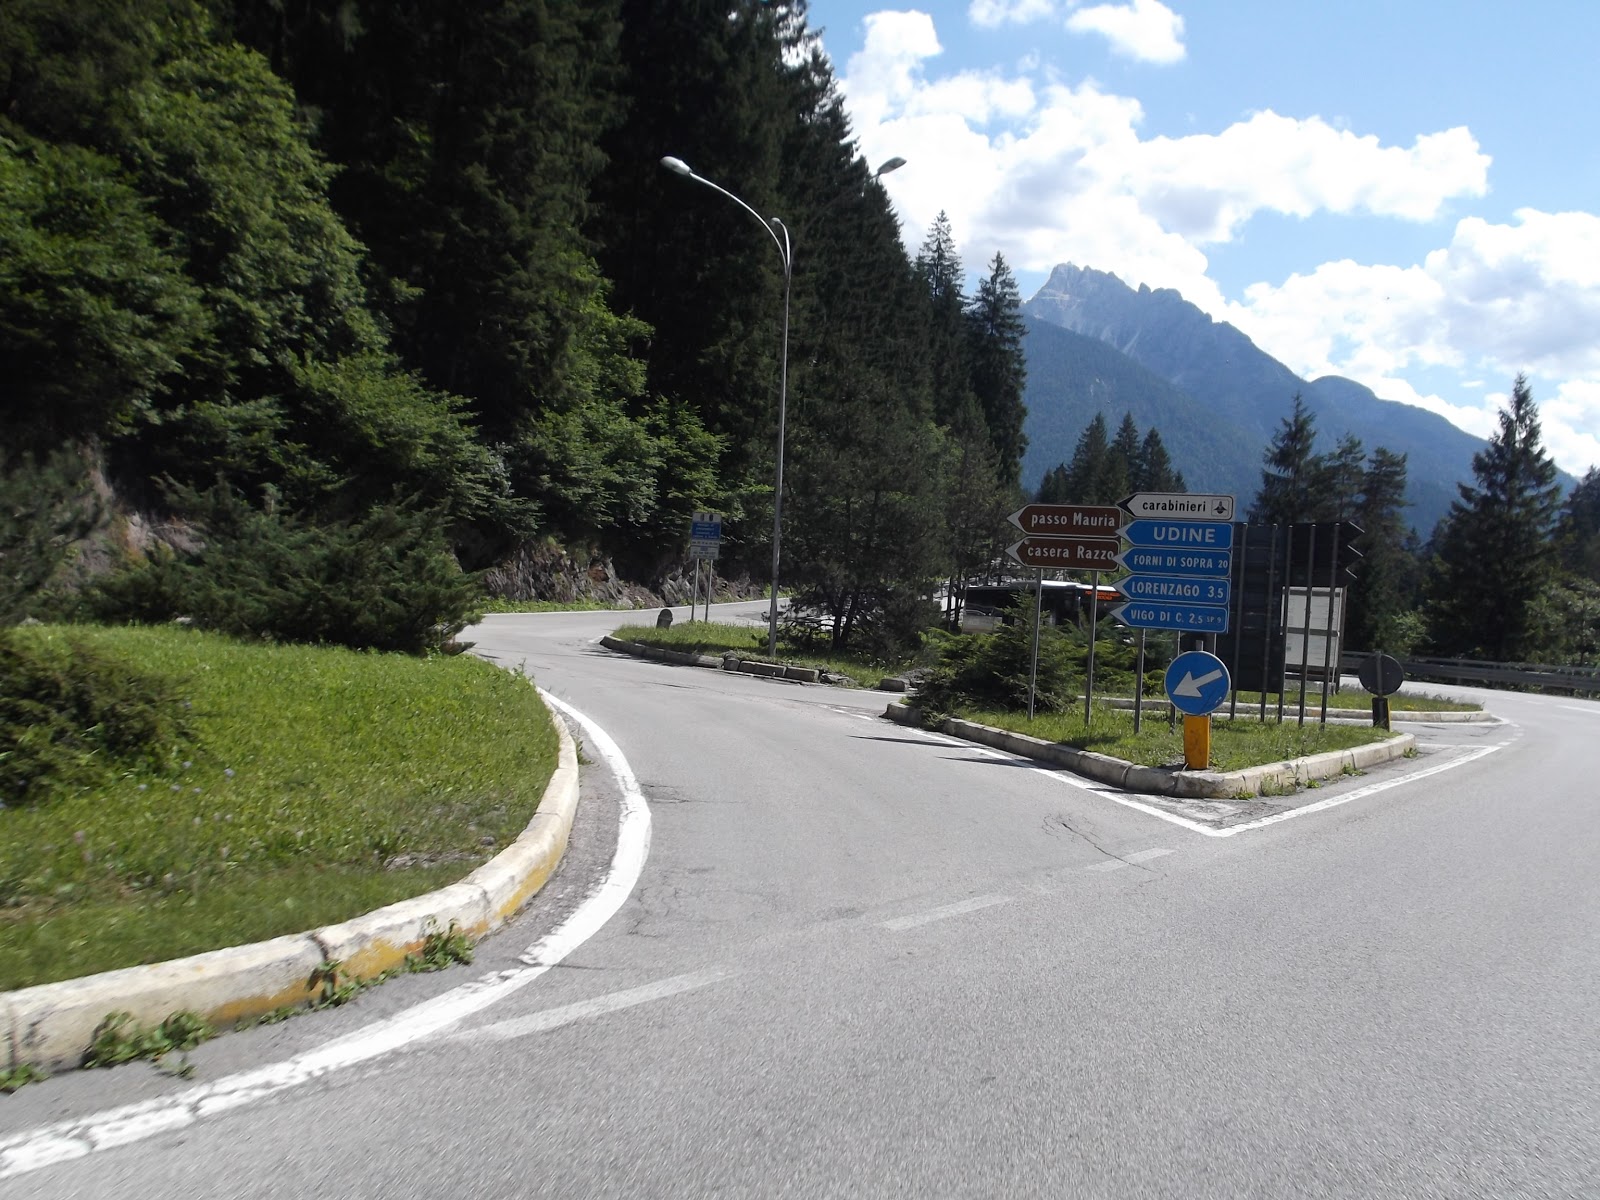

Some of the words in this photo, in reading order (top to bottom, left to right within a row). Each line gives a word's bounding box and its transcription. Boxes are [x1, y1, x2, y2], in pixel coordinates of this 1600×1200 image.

[1142, 499, 1206, 512] carabinieri
[1031, 514, 1068, 527] passo
[1073, 512, 1115, 527] Mauria
[1153, 526, 1216, 543] UDINE
[1027, 547, 1070, 559] casera
[1077, 545, 1115, 560] Razzo
[1133, 555, 1162, 567] FORNI
[1166, 556, 1176, 567] DI
[1180, 557, 1213, 569] SOPRA
[1217, 560, 1229, 569] 20
[1131, 581, 1200, 597] LORENZAGO
[1207, 585, 1224, 599] 3.5
[1130, 609, 1155, 621] VIGO
[1160, 611, 1170, 622] DI
[1188, 613, 1203, 624] 2.5
